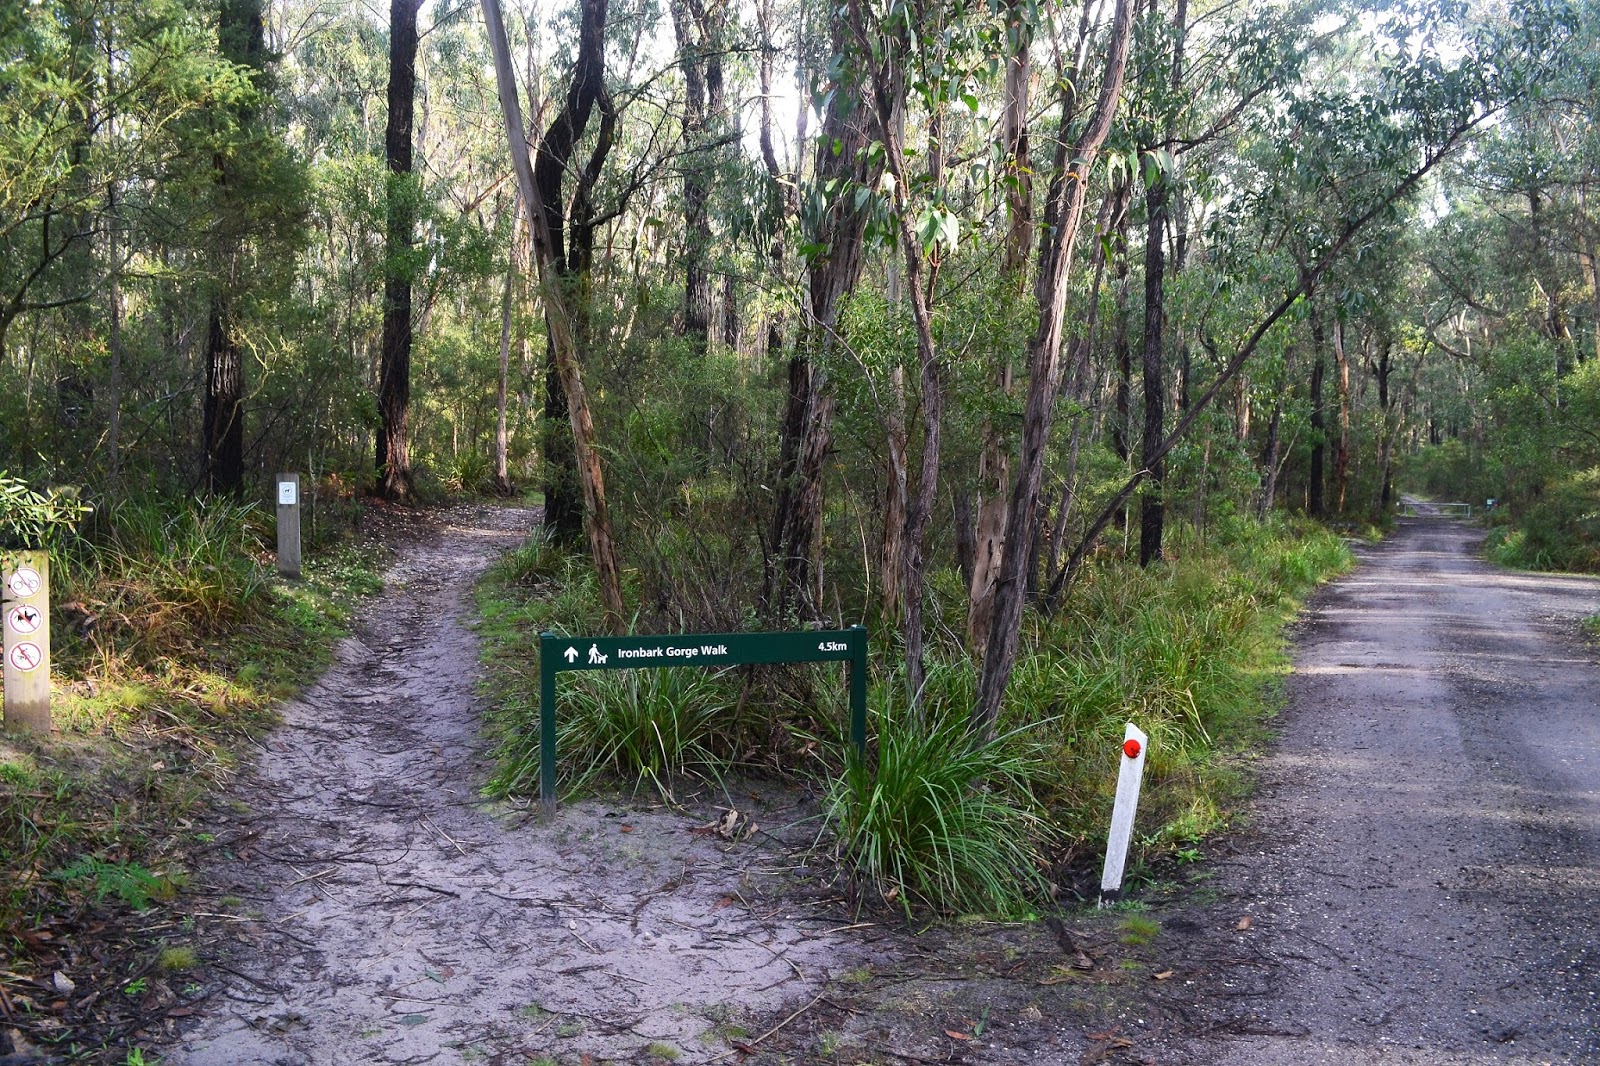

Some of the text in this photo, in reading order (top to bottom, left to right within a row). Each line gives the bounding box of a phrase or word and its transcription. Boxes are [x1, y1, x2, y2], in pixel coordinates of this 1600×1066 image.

[618, 644, 728, 659] Ironbark Gorge Walk
[818, 641, 848, 652] 4.5km
